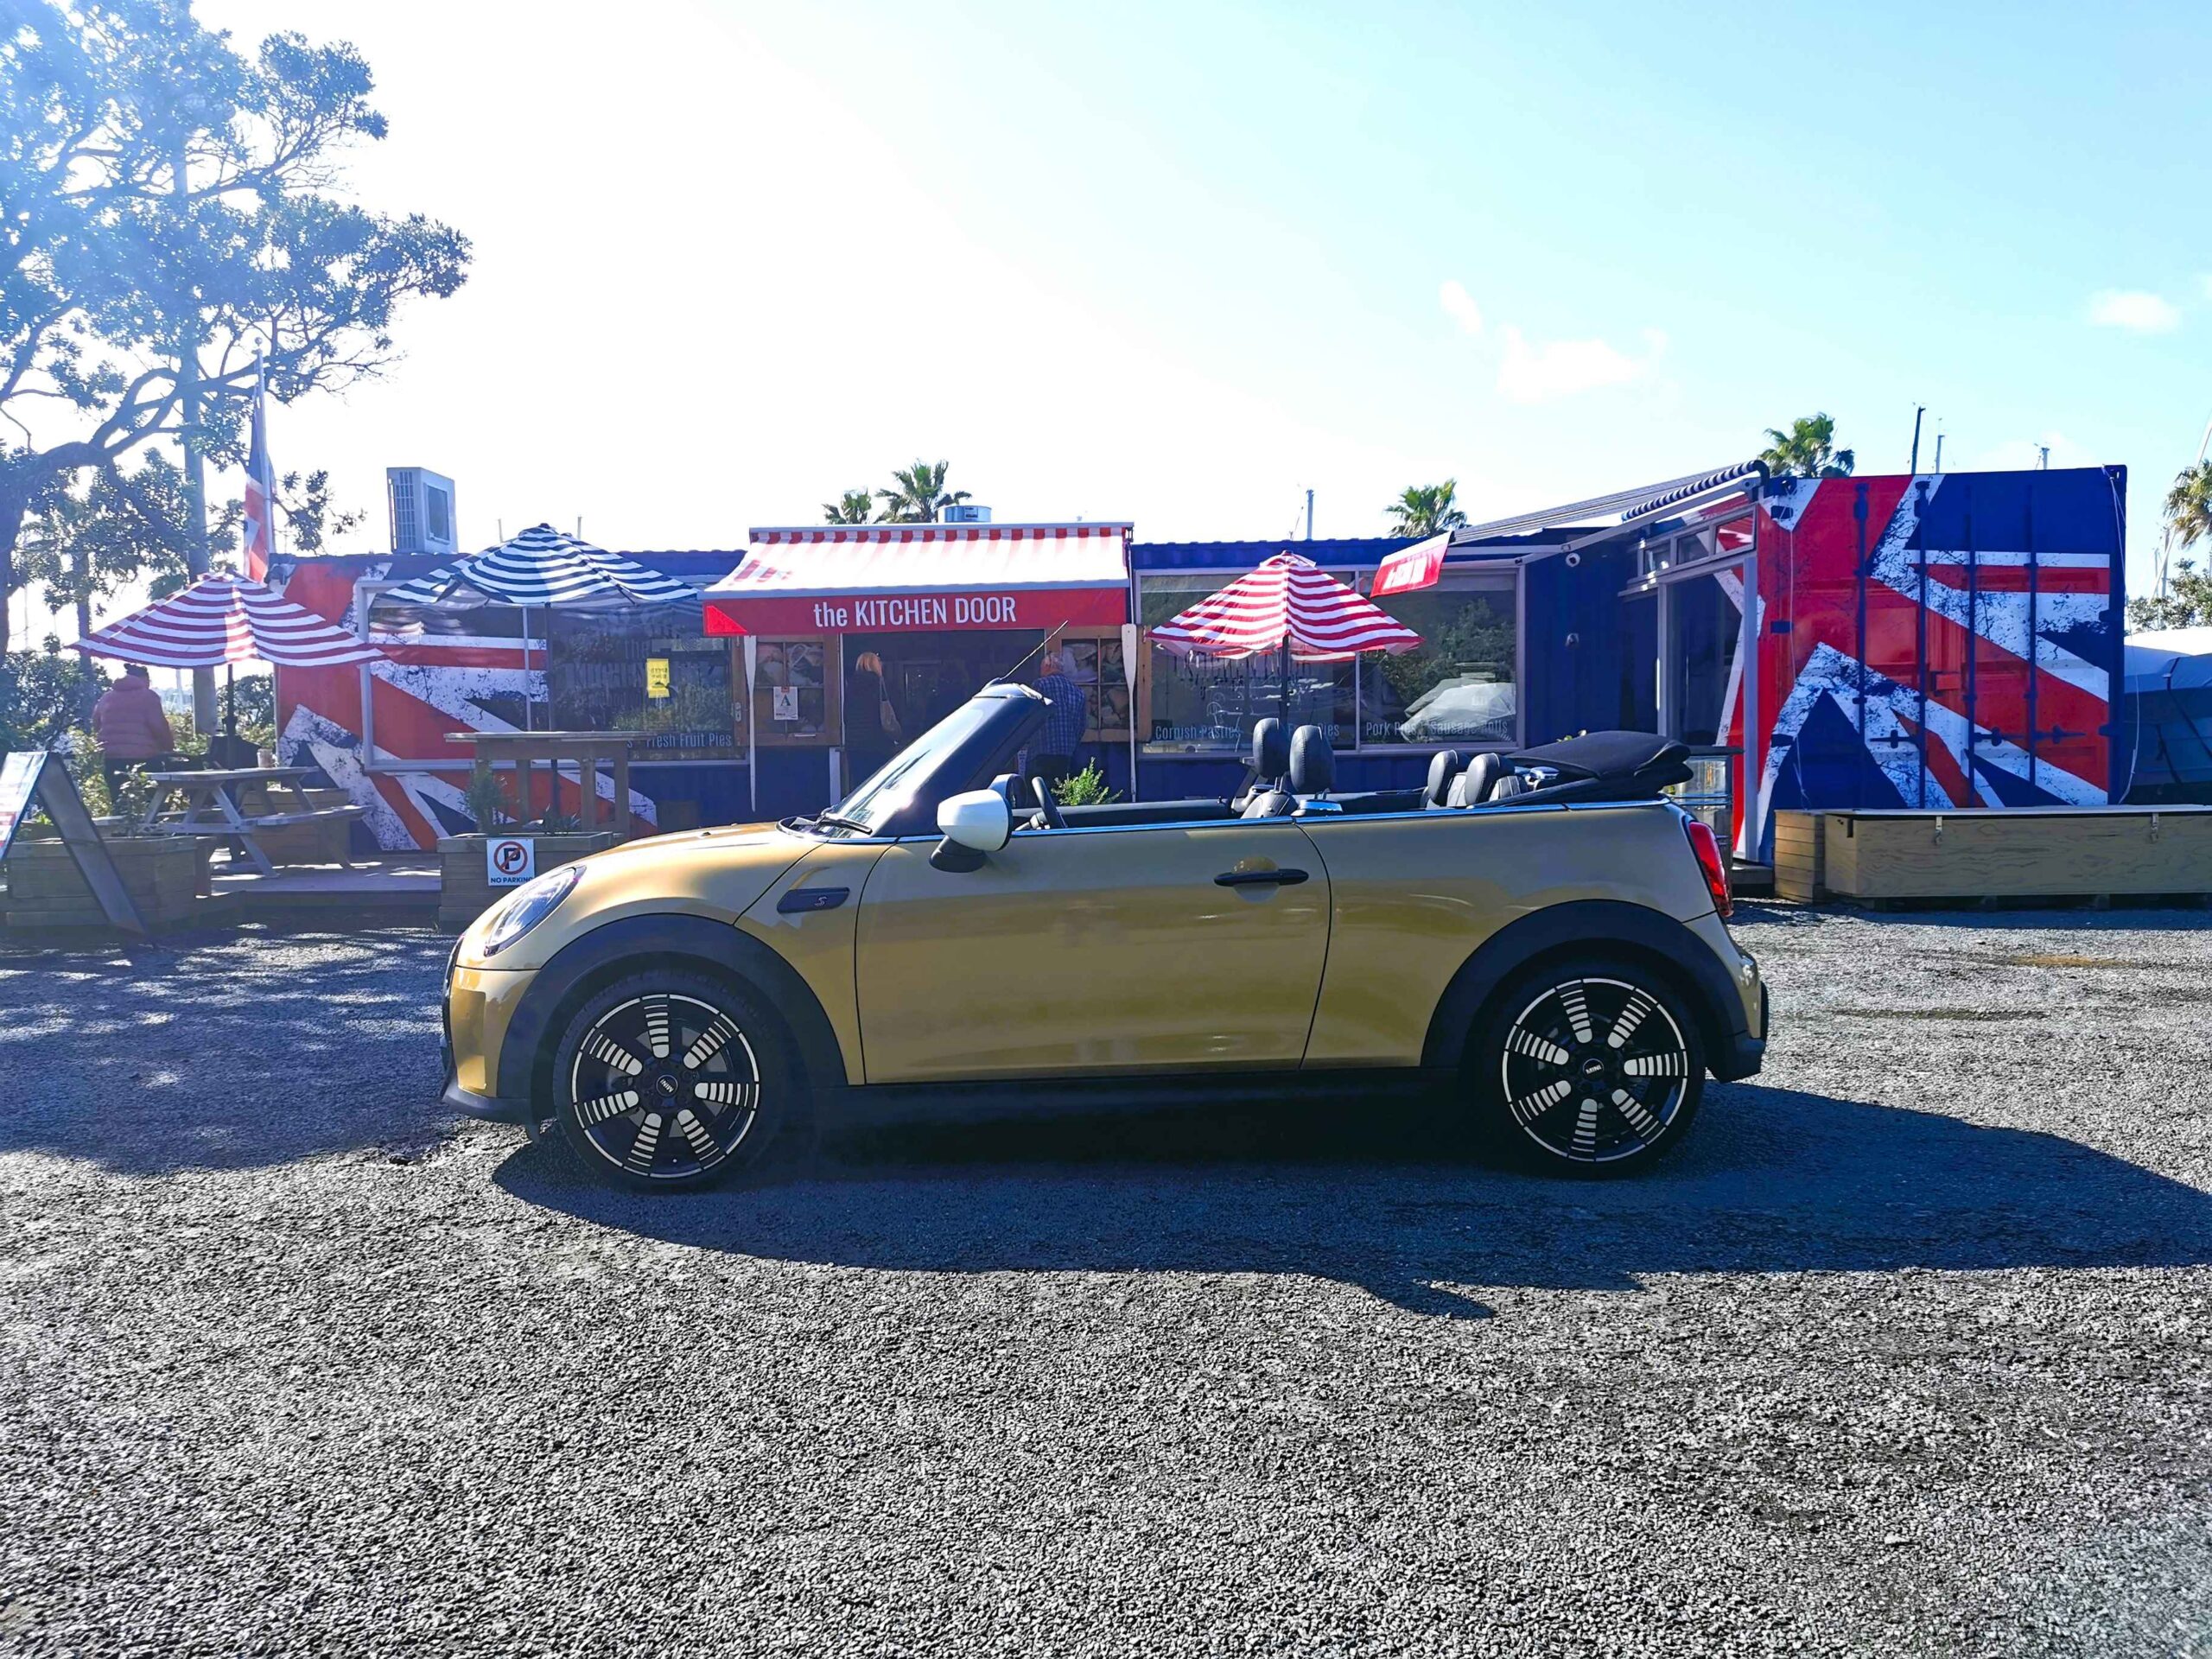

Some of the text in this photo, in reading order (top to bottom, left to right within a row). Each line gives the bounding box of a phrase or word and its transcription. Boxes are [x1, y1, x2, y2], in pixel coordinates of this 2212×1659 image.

[813, 596, 1016, 627] the KITCHEN DOOR
[780, 694, 791, 706] A
[1155, 725, 1197, 740] Cornish
[1366, 721, 1390, 736] Pork
[679, 733, 705, 747] Fruit
[709, 733, 732, 747] Pies
